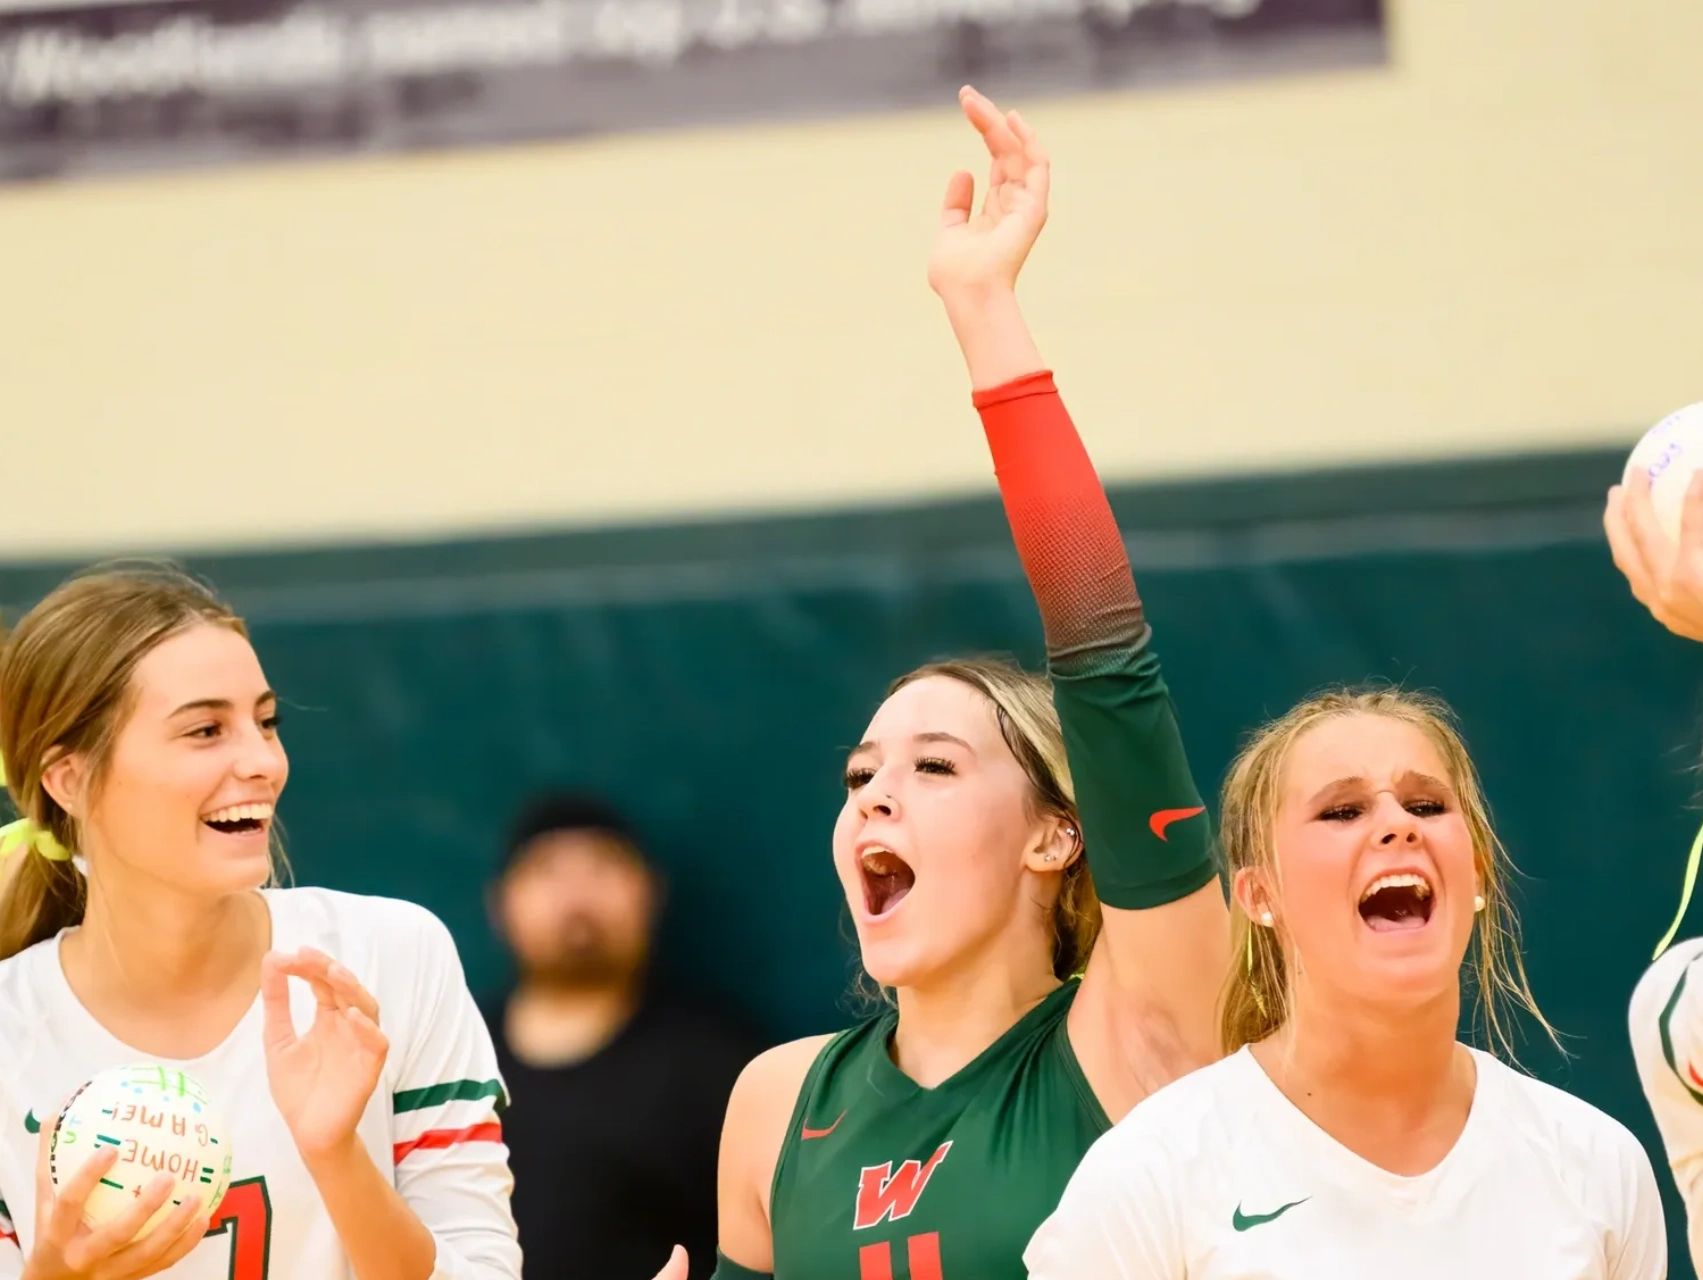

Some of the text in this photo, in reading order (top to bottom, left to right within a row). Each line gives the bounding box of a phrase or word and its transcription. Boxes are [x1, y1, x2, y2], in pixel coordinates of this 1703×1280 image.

[110, 1101, 210, 1148] GAME!
[121, 1138, 200, 1183] HOME
[853, 1139, 954, 1230] W
